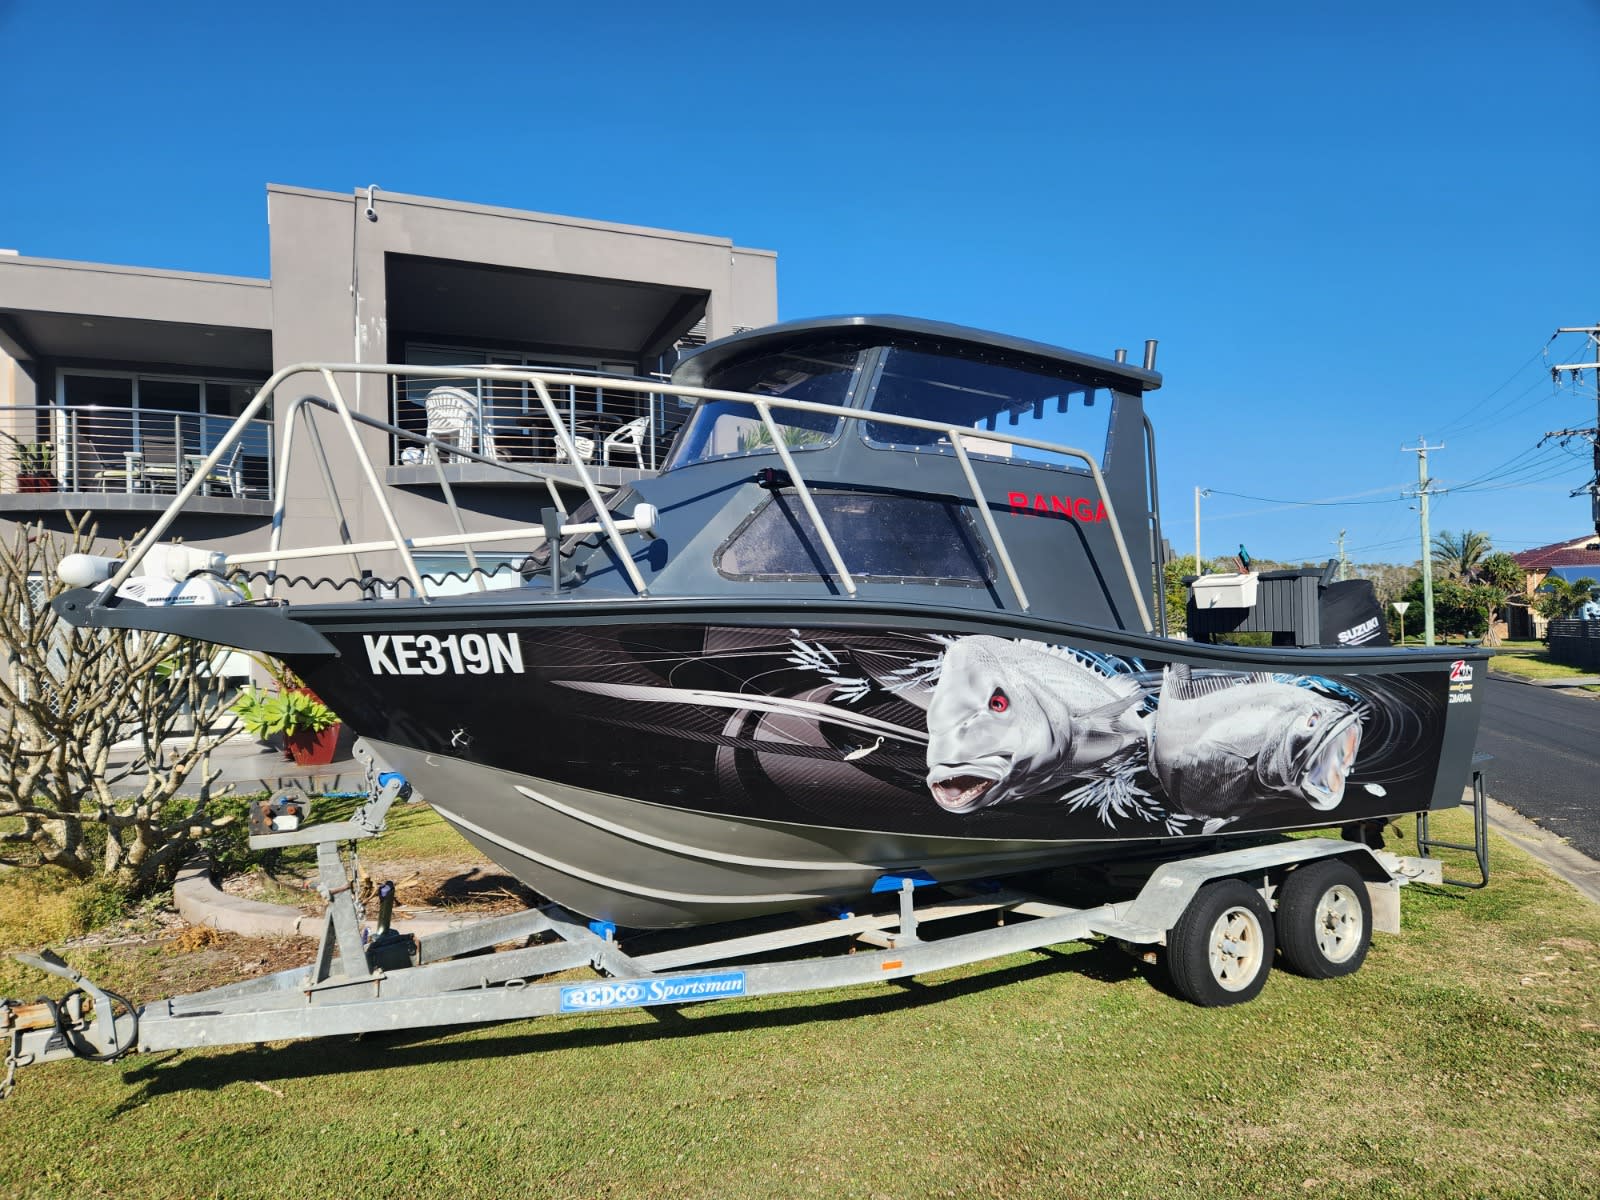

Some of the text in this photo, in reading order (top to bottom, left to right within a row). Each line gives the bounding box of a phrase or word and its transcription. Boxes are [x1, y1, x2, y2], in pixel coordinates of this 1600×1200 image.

[1007, 491, 1111, 525] RANGA
[1337, 616, 1380, 643] SUZUKI
[362, 632, 526, 676] KE319N
[569, 978, 743, 1007] REDCO Sportsman
